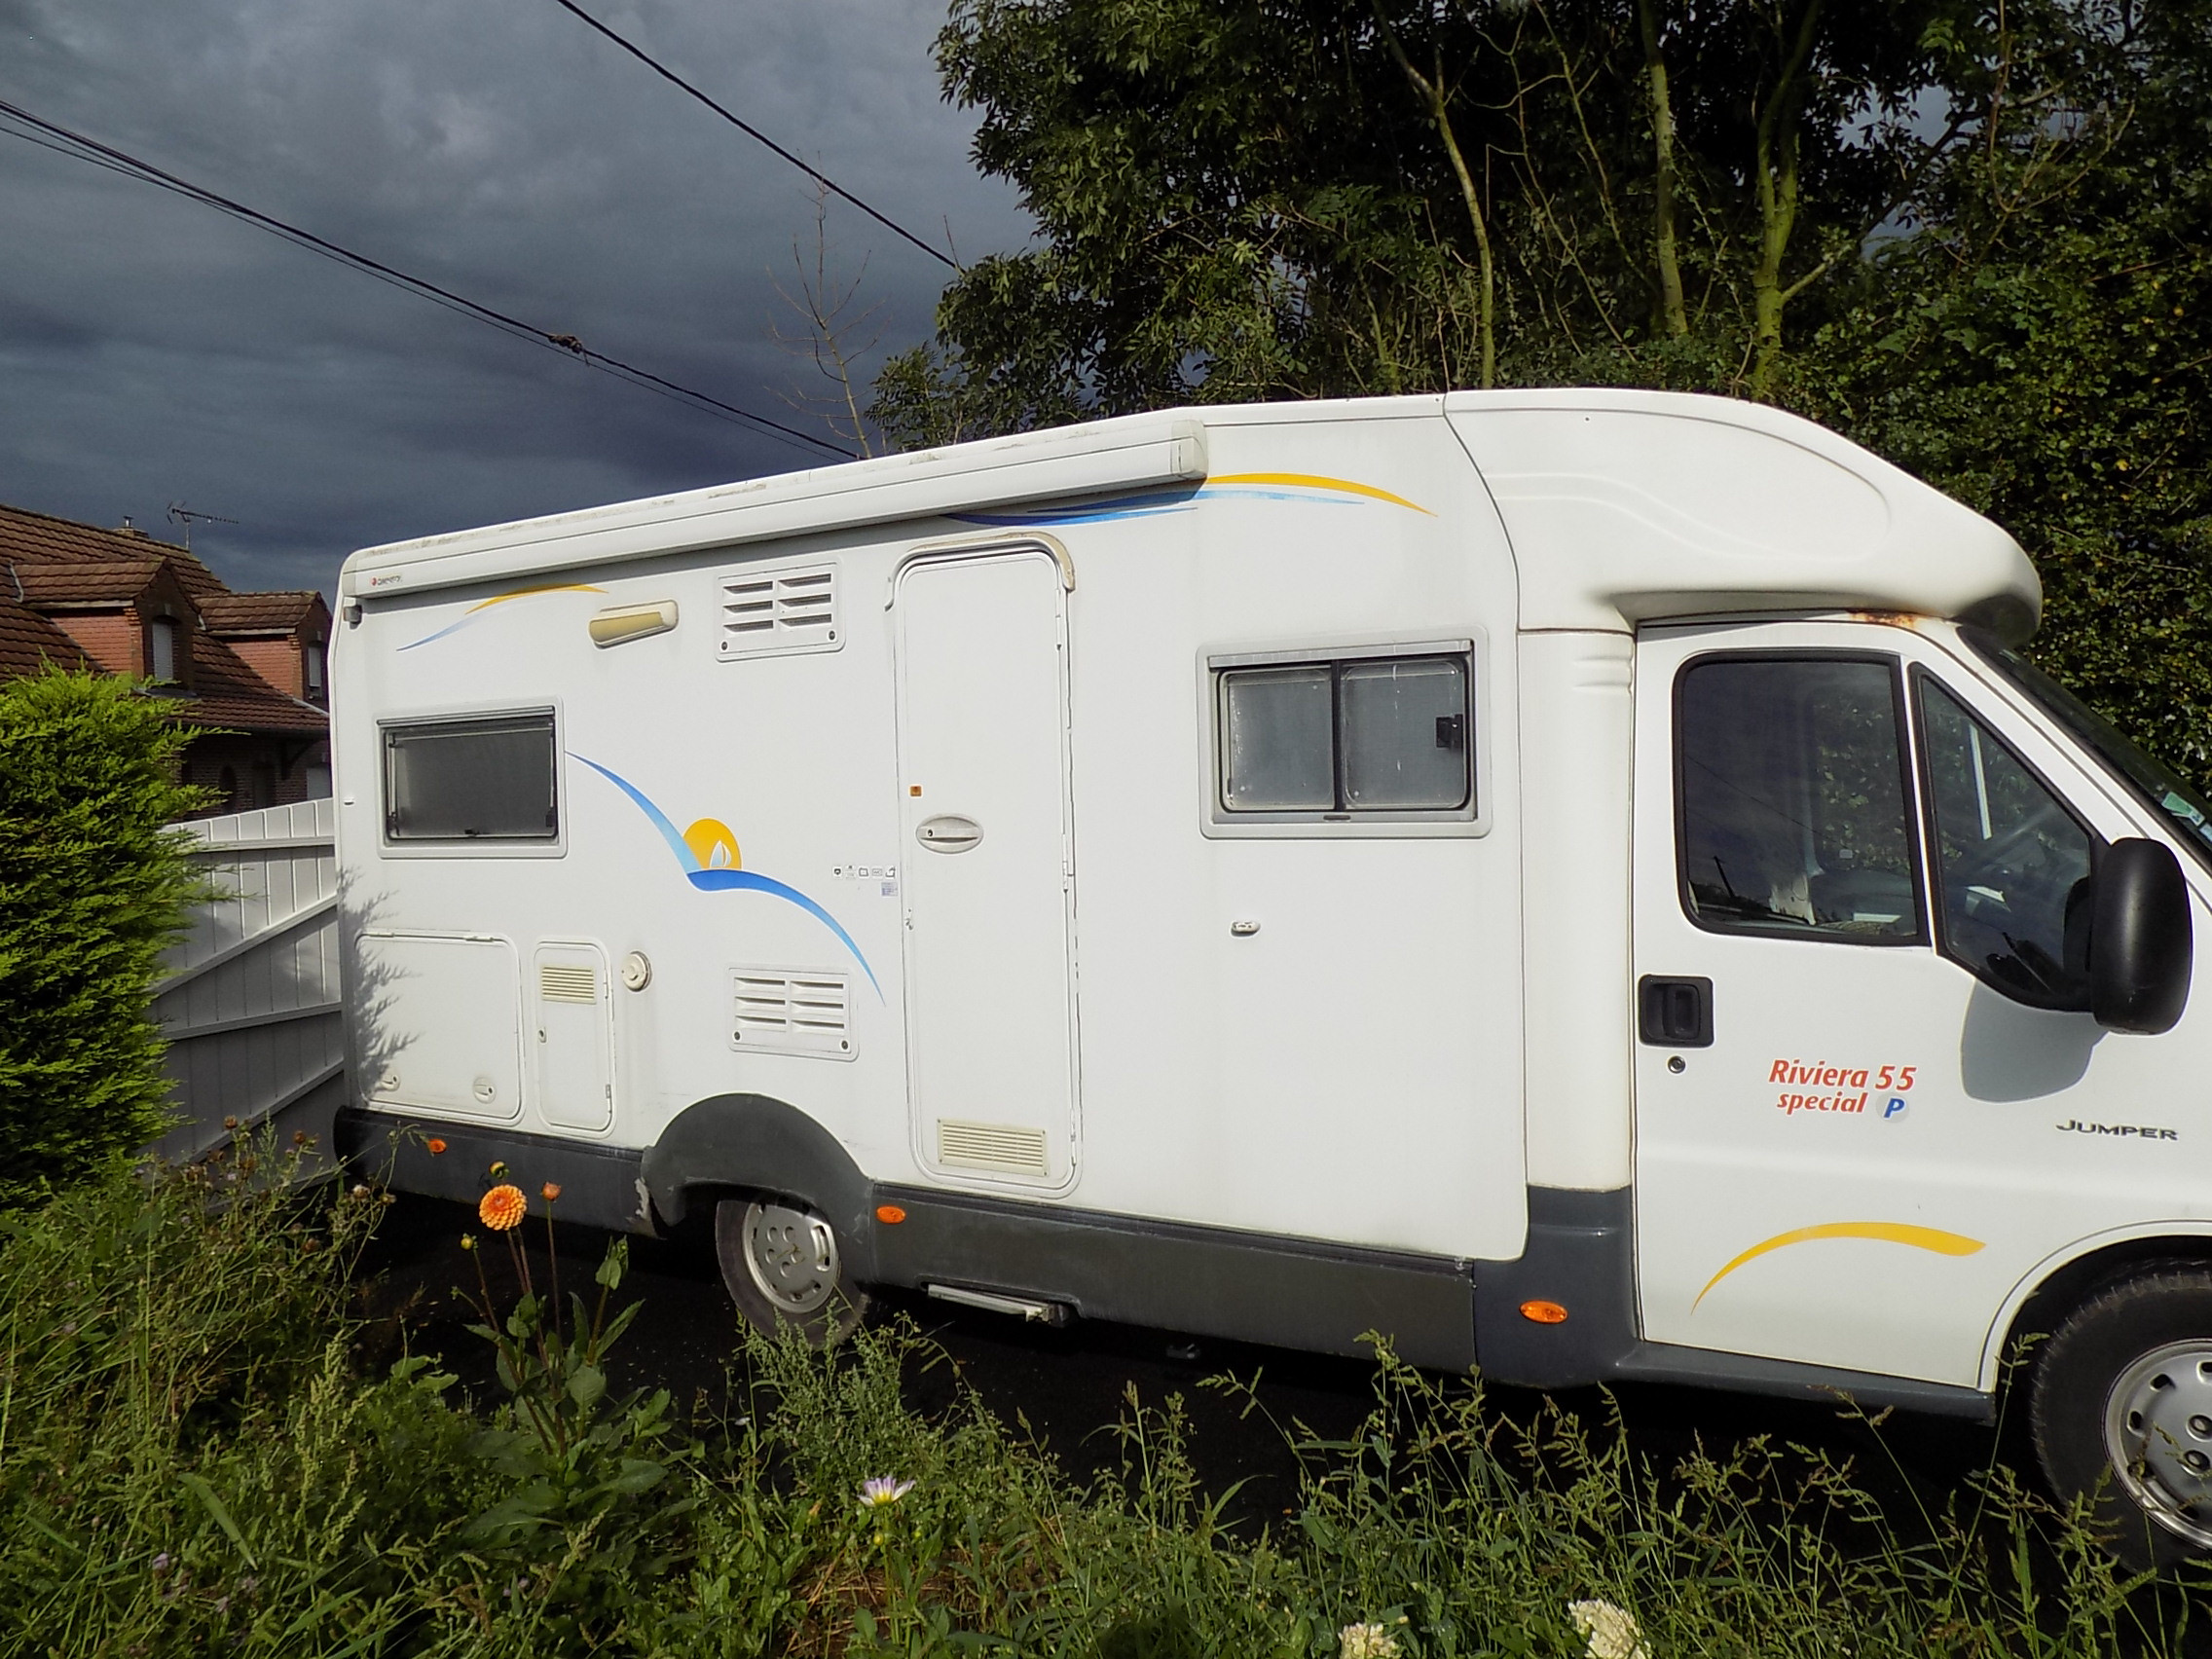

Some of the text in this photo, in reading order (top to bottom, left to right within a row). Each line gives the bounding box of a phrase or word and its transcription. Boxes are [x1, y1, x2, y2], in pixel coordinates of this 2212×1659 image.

[1768, 1058, 1917, 1091] Riviera 55
[1776, 1090, 1905, 1119] special P
[2055, 1119, 2179, 1141] JUMPER
